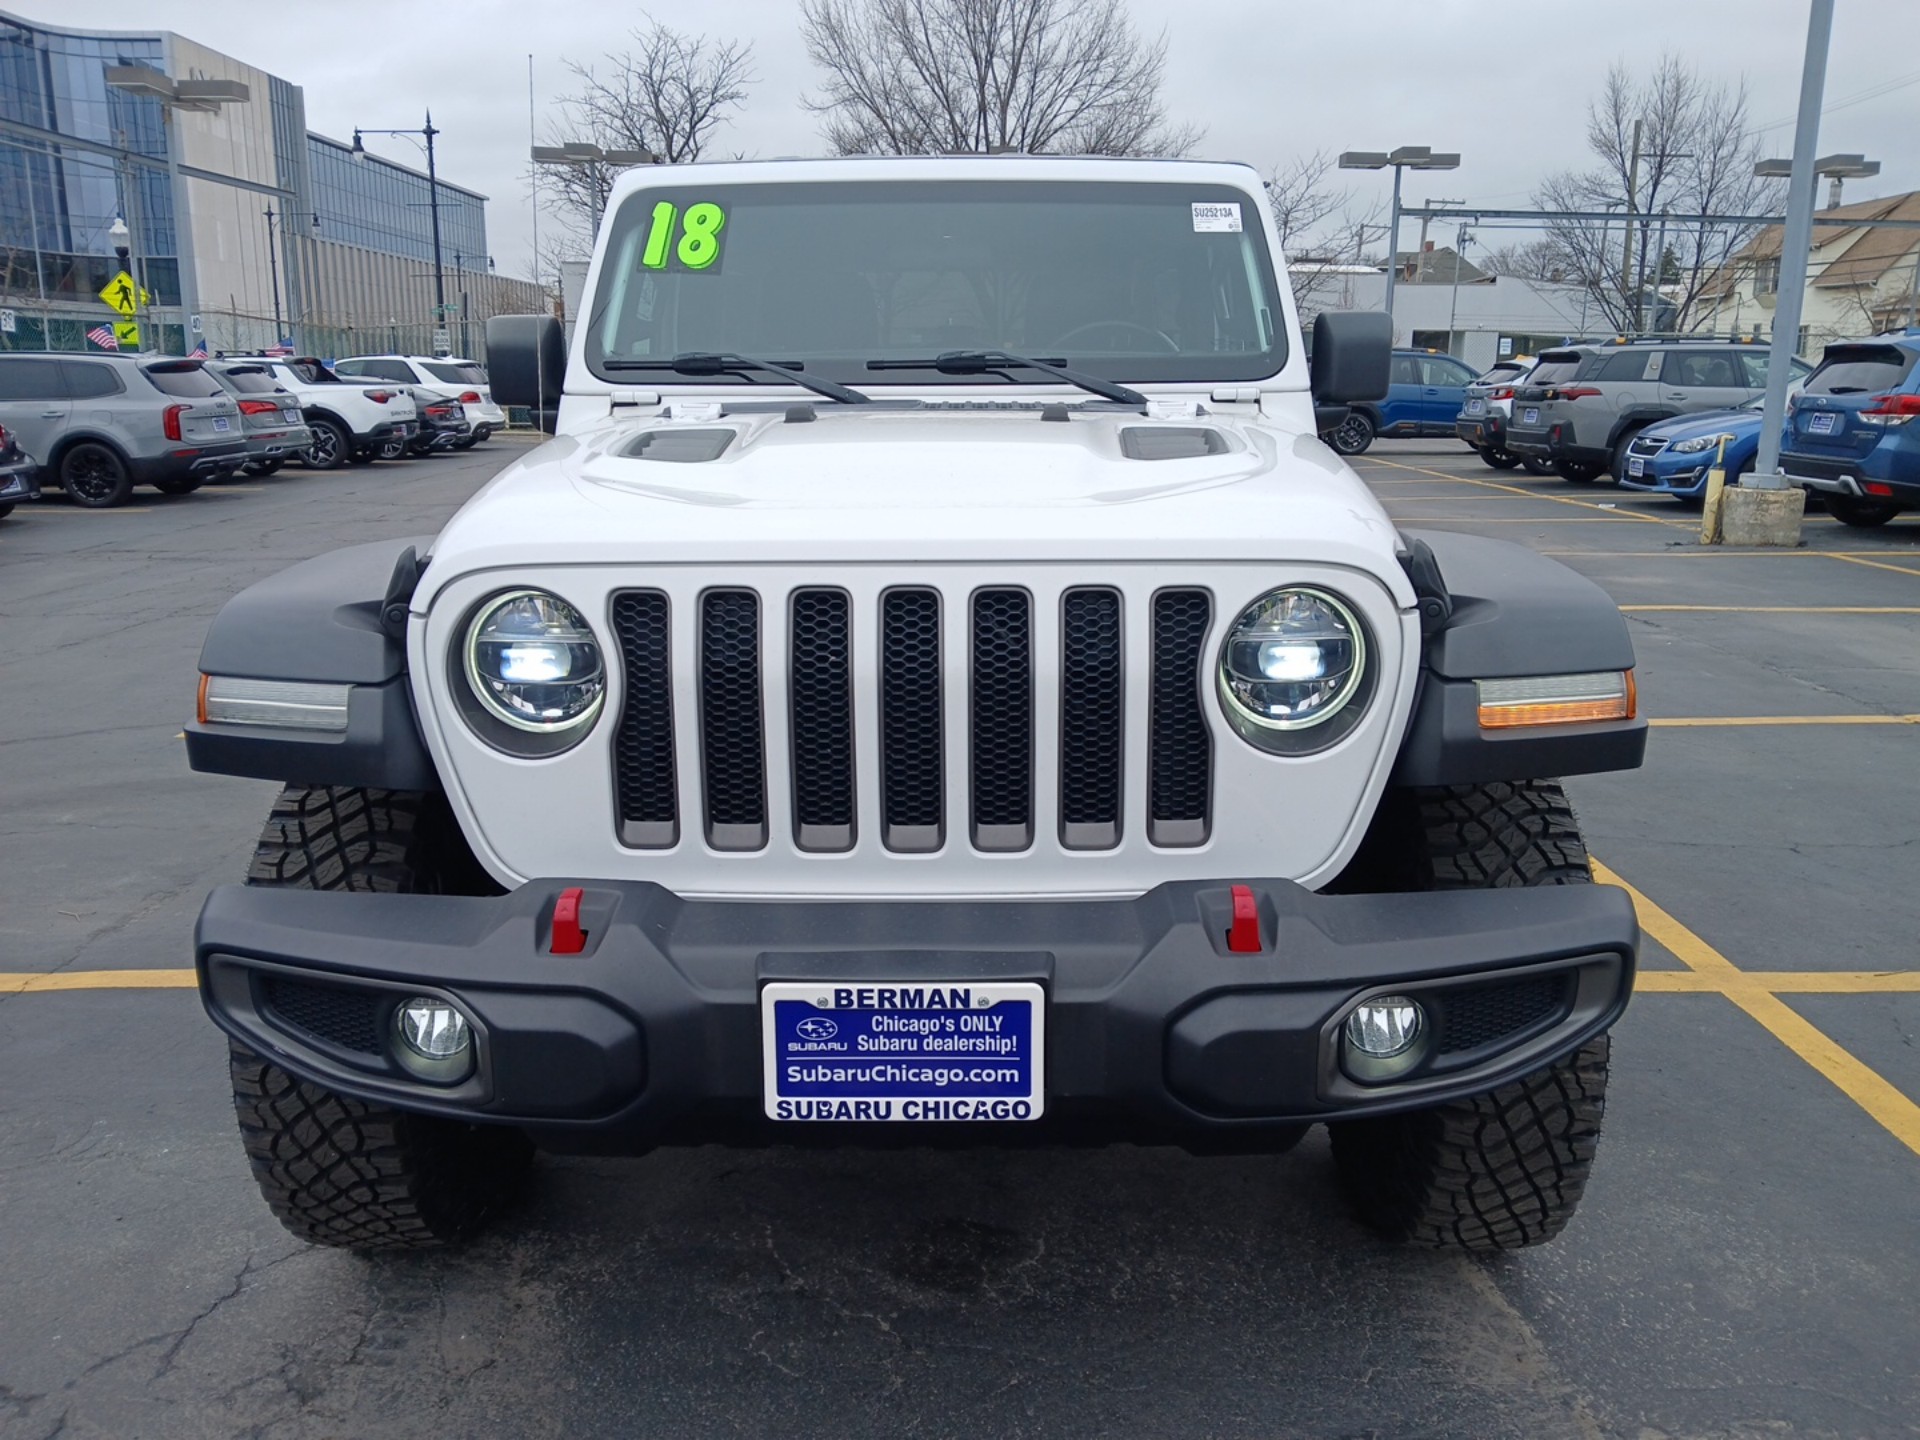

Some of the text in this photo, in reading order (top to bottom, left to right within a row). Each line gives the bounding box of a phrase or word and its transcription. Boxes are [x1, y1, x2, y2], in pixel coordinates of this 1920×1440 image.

[1194, 207, 1234, 218] SU25213A
[642, 201, 725, 270] 18
[834, 988, 971, 1009] BERMAN
[871, 1015, 1003, 1035] Chicago's ONLY
[787, 1042, 848, 1051] SUBARU
[857, 1034, 1018, 1055] Subaru dealership!
[787, 1064, 1020, 1086] SubaruChicago.com
[776, 1100, 1032, 1120] SUBARU CHICAGO
